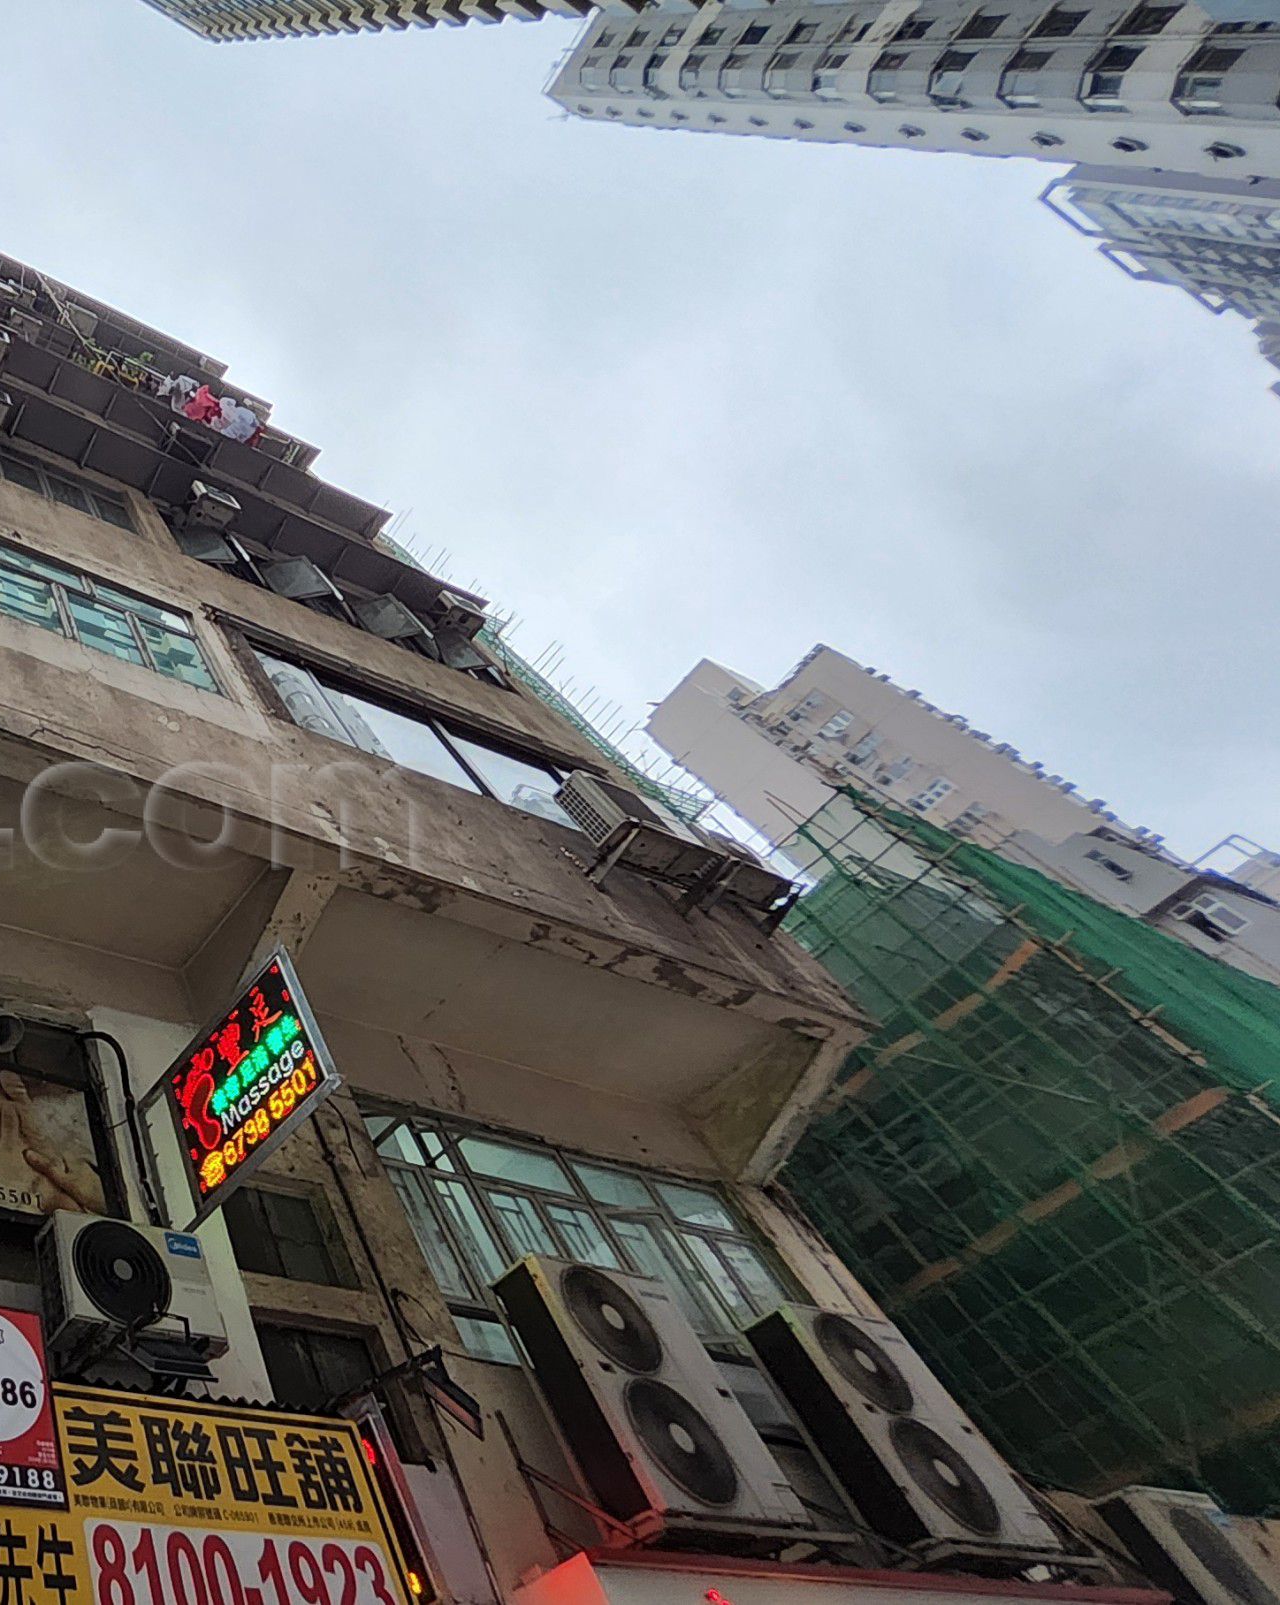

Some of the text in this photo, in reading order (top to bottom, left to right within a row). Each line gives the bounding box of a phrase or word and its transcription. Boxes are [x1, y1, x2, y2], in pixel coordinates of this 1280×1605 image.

[221, 1039, 305, 1135] Massage
[269, 1057, 317, 1120] 5501
[167, 1237, 199, 1254] Midea
[63, 1406, 365, 1514] 美聯旺舖
[92, 1523, 395, 1605] 8100-1923
